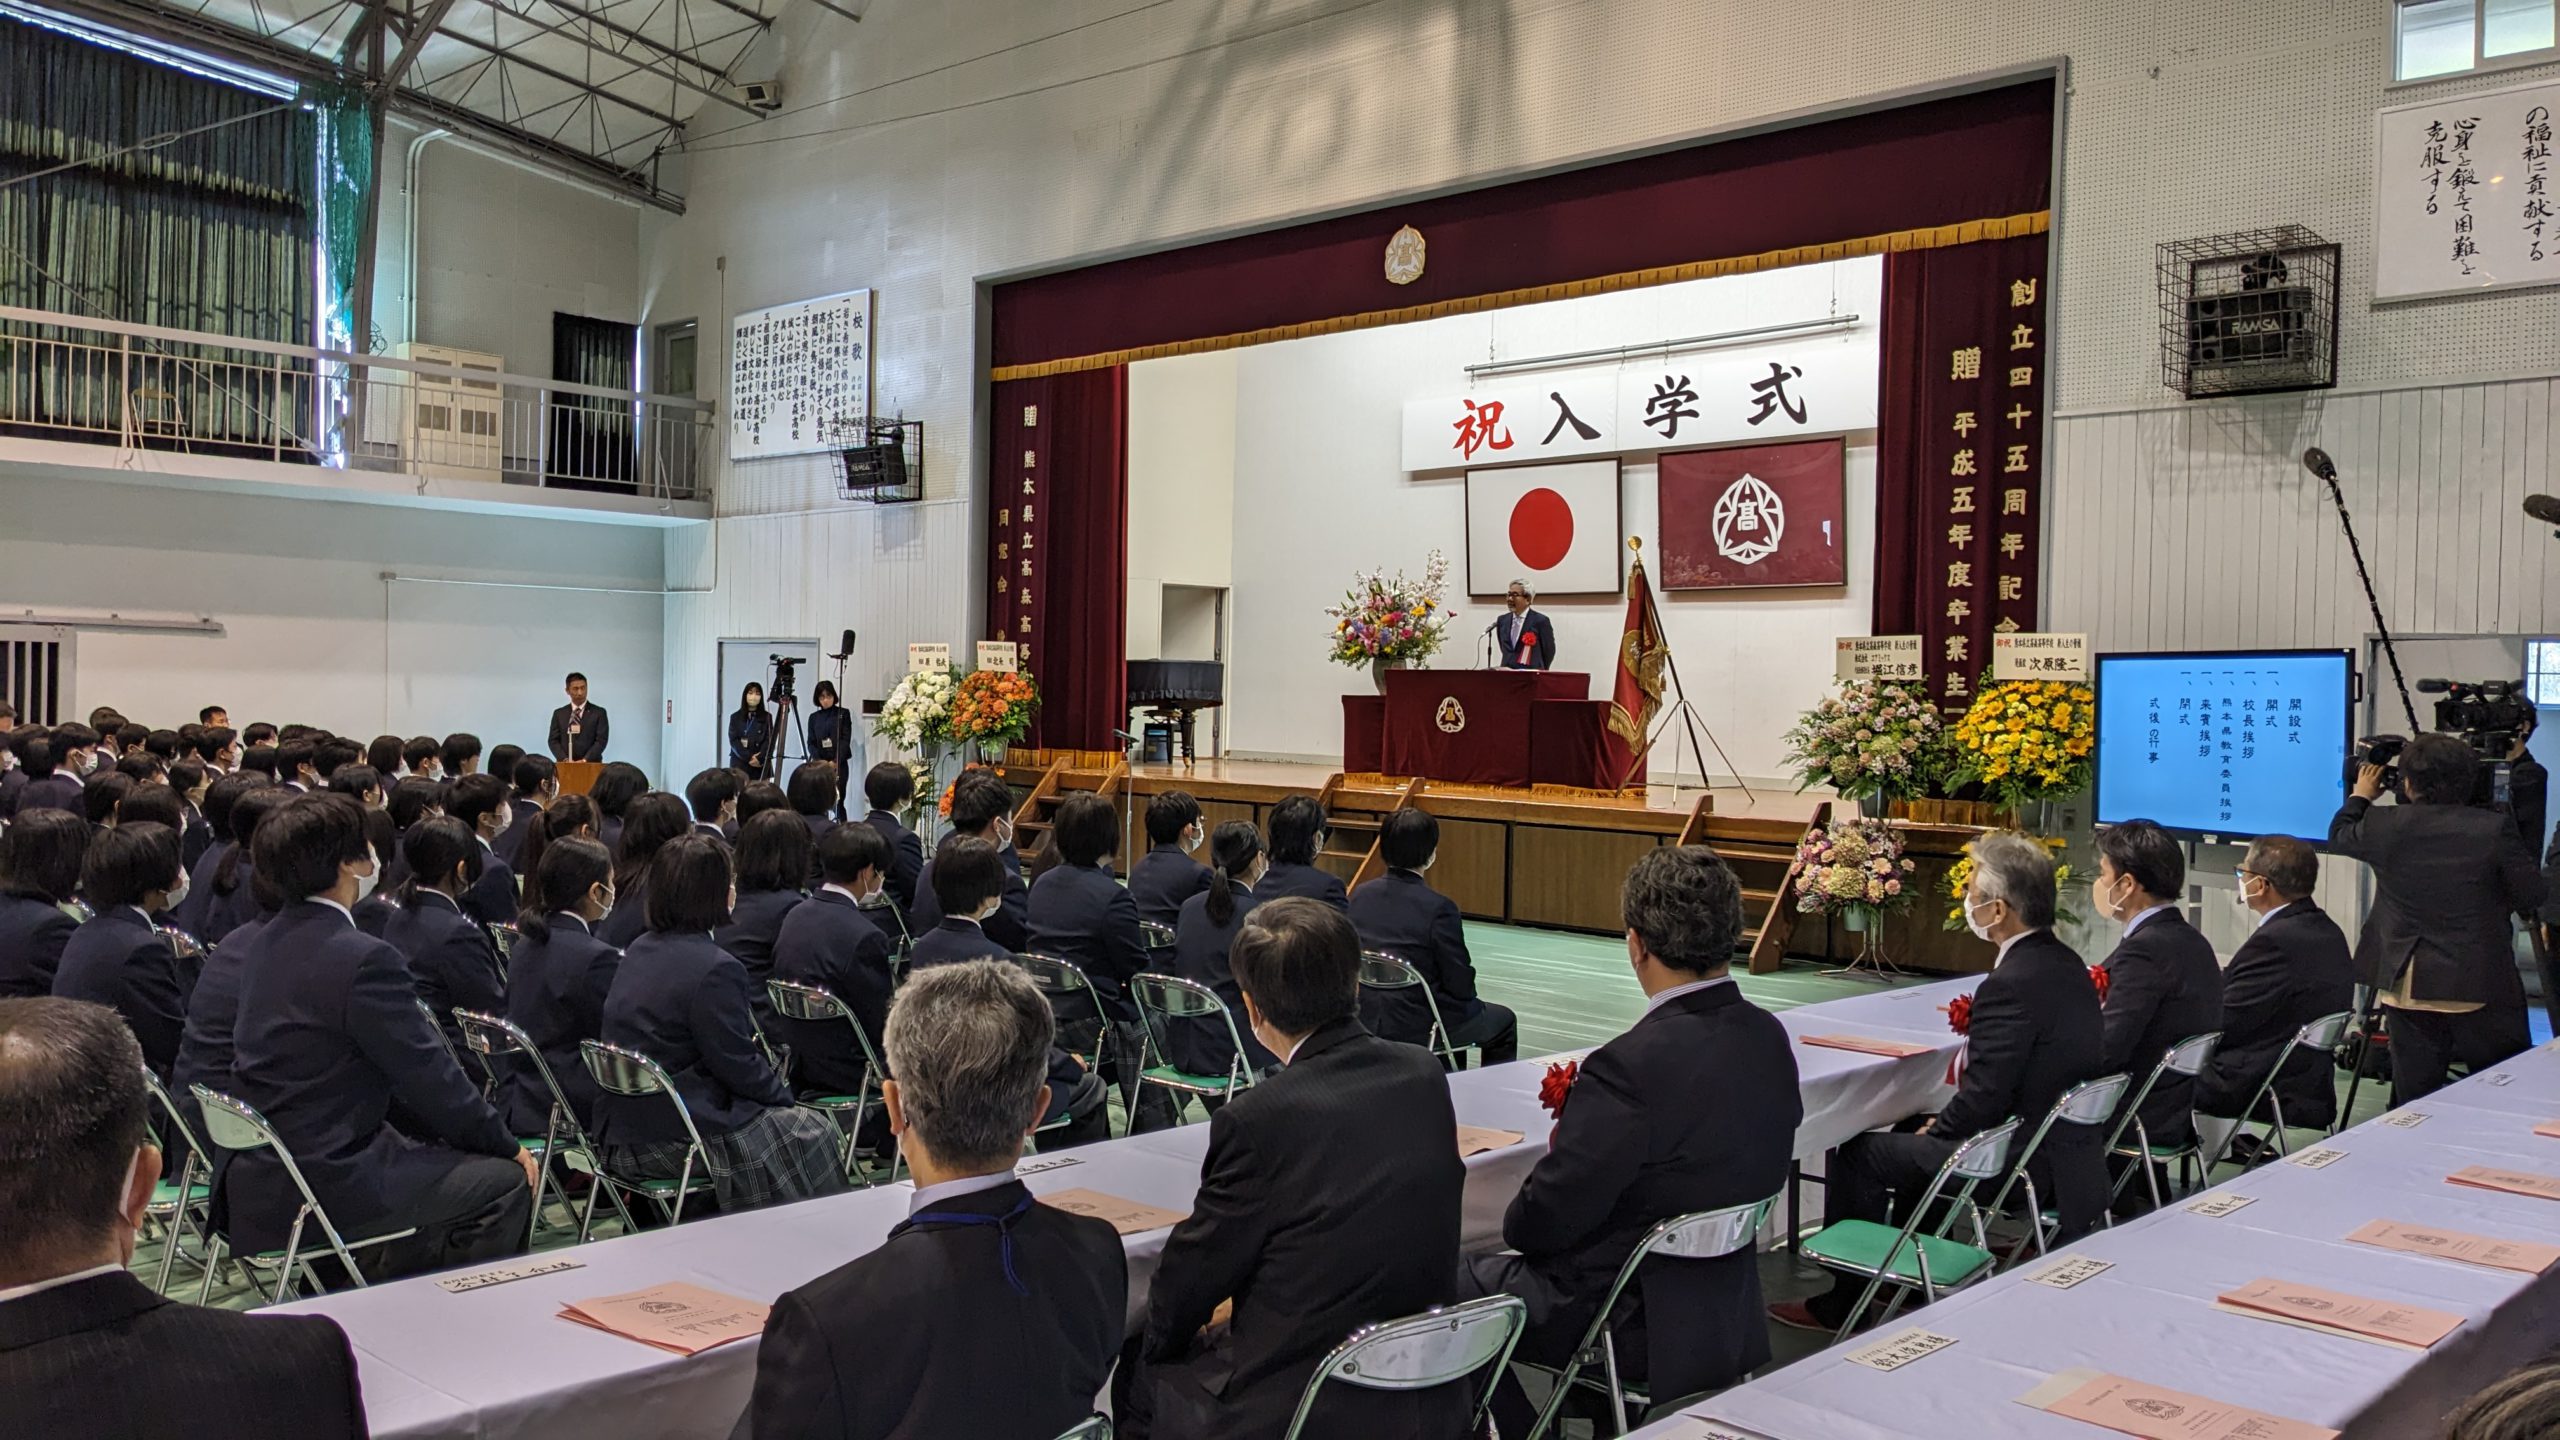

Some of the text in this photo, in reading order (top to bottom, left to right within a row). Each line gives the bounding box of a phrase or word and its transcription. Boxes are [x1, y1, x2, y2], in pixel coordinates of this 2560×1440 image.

[2420, 120, 2450, 215] 克服する
[2521, 106, 2554, 261] の福祉に貢献する
[851, 311, 864, 362] 校歌
[2231, 318, 2281, 335] RAMSA
[1452, 362, 1809, 461] 祝入学式
[2029, 657, 2081, 672] 次原隆二
[2147, 697, 2161, 765] 式後の行事
[2287, 698, 2302, 745] 開設式
